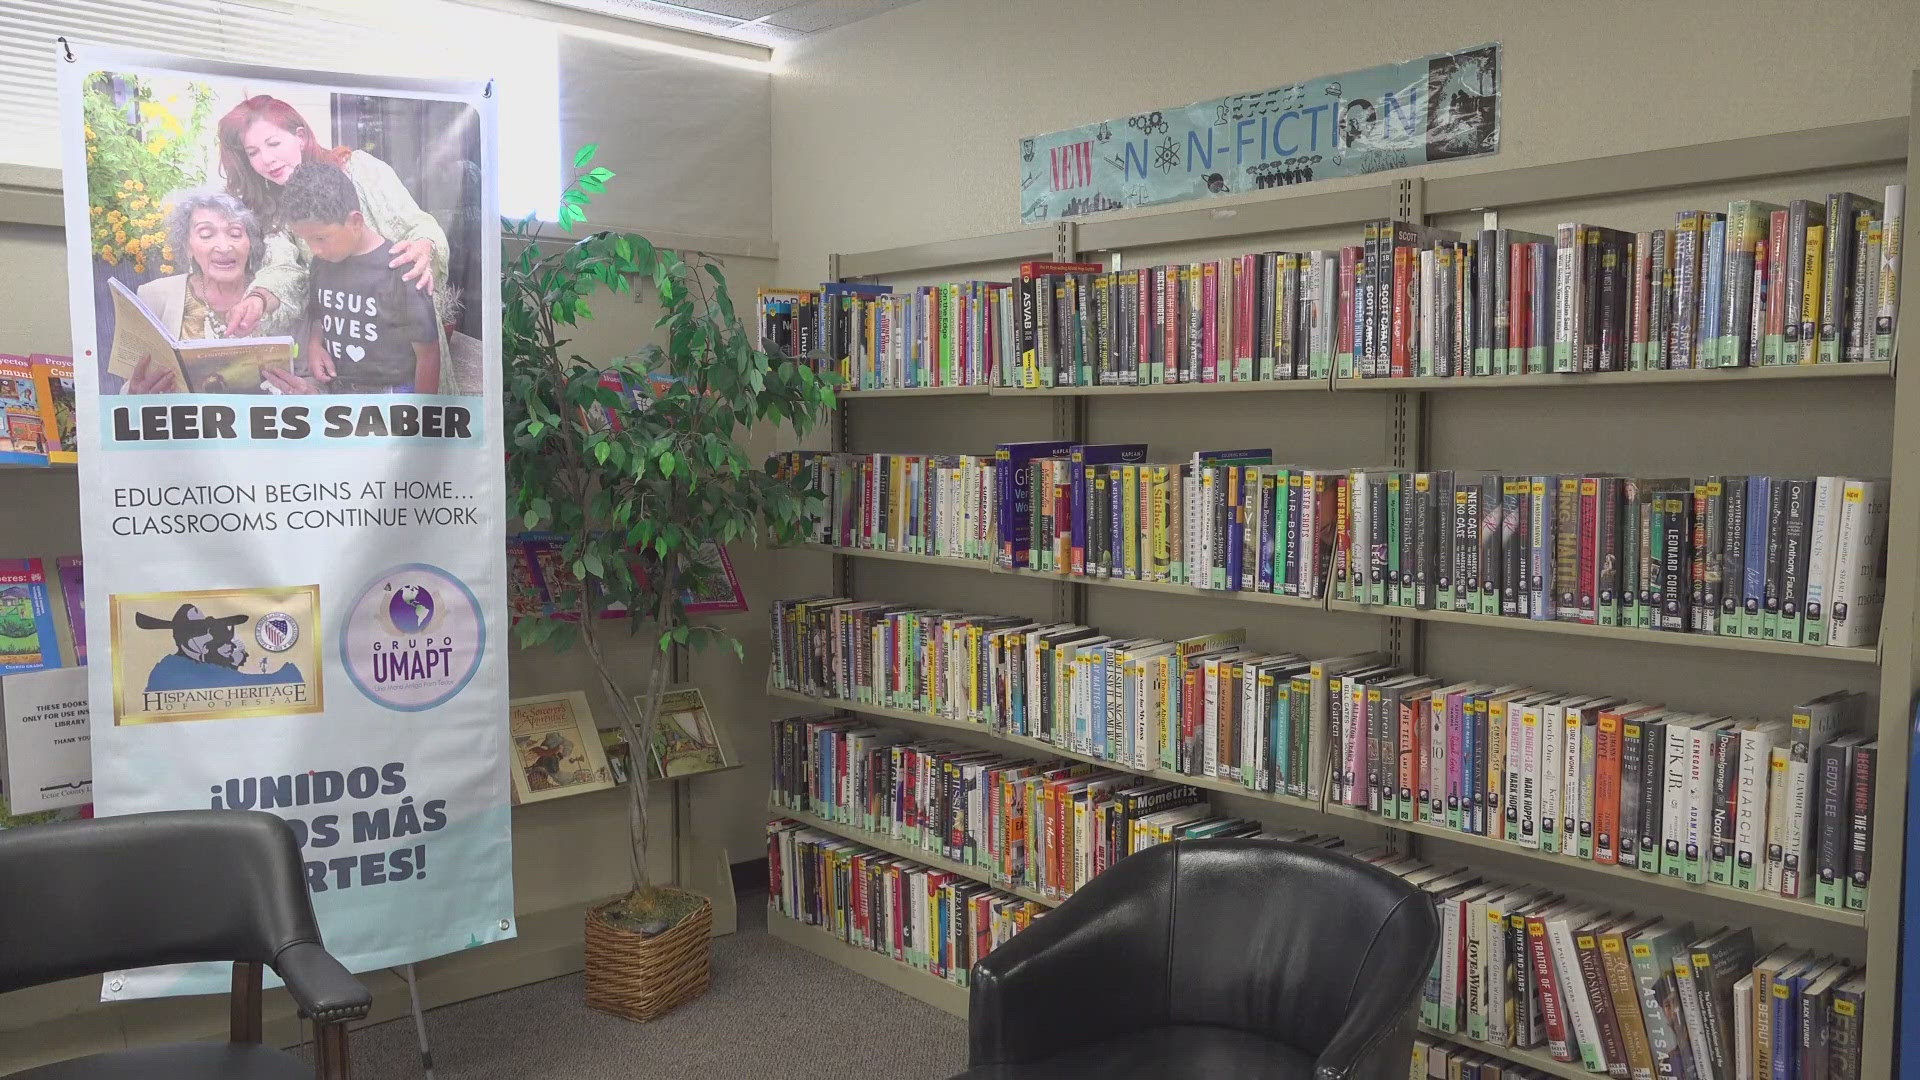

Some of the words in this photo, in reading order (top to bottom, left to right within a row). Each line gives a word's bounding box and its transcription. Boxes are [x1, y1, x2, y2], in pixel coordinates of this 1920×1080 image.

[1049, 140, 1096, 192] NEW
[1398, 230, 1418, 243] SCOTT
[943, 288, 948, 300] On
[1381, 284, 1389, 316] SCOTT
[1888, 275, 1896, 305] GOING
[321, 314, 378, 341] OVES
[113, 405, 237, 441] LEER
[249, 405, 311, 439] ES
[323, 404, 472, 438] SABER
[1121, 450, 1142, 458] KAPLAN
[115, 484, 255, 508] EDUCATION
[265, 481, 351, 502] BEGINS
[360, 481, 386, 500] AT
[1337, 487, 1345, 507] DAVE
[1468, 492, 1477, 515] NEKO
[1792, 486, 1800, 500] On
[112, 512, 277, 536] CLASSROOMS
[286, 508, 407, 530] CONTINUE
[414, 507, 478, 525] WORK
[1154, 489, 1162, 530] Slither
[1791, 501, 1799, 517] Call
[1287, 489, 1296, 567] AIR-BORNE
[1302, 513, 1310, 538] SHOTS
[1403, 518, 1412, 553] Brinkley
[1457, 517, 1465, 538] CASE
[1468, 518, 1477, 539] CASE
[1814, 515, 1825, 557] FRANCIS
[1667, 529, 1679, 571] LEONARD
[1786, 540, 1797, 574] Anthony
[1785, 576, 1796, 600] Fauci,
[374, 637, 452, 651] GRUPO
[374, 648, 452, 683] UMAPT
[142, 688, 224, 711] HISPANIC
[228, 684, 307, 702] HERITAGE
[1245, 670, 1253, 701] TINA
[36, 704, 60, 712] THESE
[62, 701, 87, 709] BOOKS
[166, 702, 188, 711] OF
[208, 697, 290, 708] ODESSA
[55, 719, 86, 727] LIBRARY
[1332, 702, 1341, 737] Garten
[1349, 702, 1359, 740] ALLIGATOR
[1382, 698, 1392, 739] Karen
[1546, 713, 1554, 742] Lovely
[1793, 718, 1807, 726] NEW
[1625, 728, 1638, 736] NEW
[1647, 731, 1655, 753] ONCE
[1546, 744, 1554, 764] One
[1599, 731, 1608, 760] JOYCE
[1669, 734, 1685, 766] JFK
[1647, 755, 1655, 777] UPON
[1691, 738, 1700, 781] RENEGADE
[1717, 736, 1730, 792] Doppelganger
[1509, 772, 1518, 794] MARK
[1524, 778, 1533, 799] MARK
[1668, 770, 1683, 793] JR.
[1826, 758, 1839, 796] GEDDY
[1137, 786, 1198, 808] Mometrix
[1739, 738, 1755, 844] MATRIARCH
[1794, 772, 1805, 819] GLAMOUR
[352, 795, 447, 844] MÁS
[1690, 806, 1698, 829] ADAM
[1824, 798, 1837, 818] LEE
[1713, 808, 1726, 847] Naomi
[1853, 814, 1867, 831] THE
[1853, 832, 1865, 851] MAN
[304, 844, 426, 893] RTES!
[1516, 953, 1524, 968] AND
[1533, 940, 1548, 975] TRAITOR
[1517, 971, 1525, 992] LIARS
[1540, 978, 1550, 989] OF
[1542, 991, 1557, 1026] ARNHEM
[1802, 999, 1810, 1018] BLACK
[1837, 1003, 1851, 1012] NEW
[1640, 976, 1661, 1020] LAST
[1651, 1027, 1673, 1073] TSAR
[1757, 1003, 1769, 1048] BEIRUT
[1759, 1050, 1768, 1072] JACK
